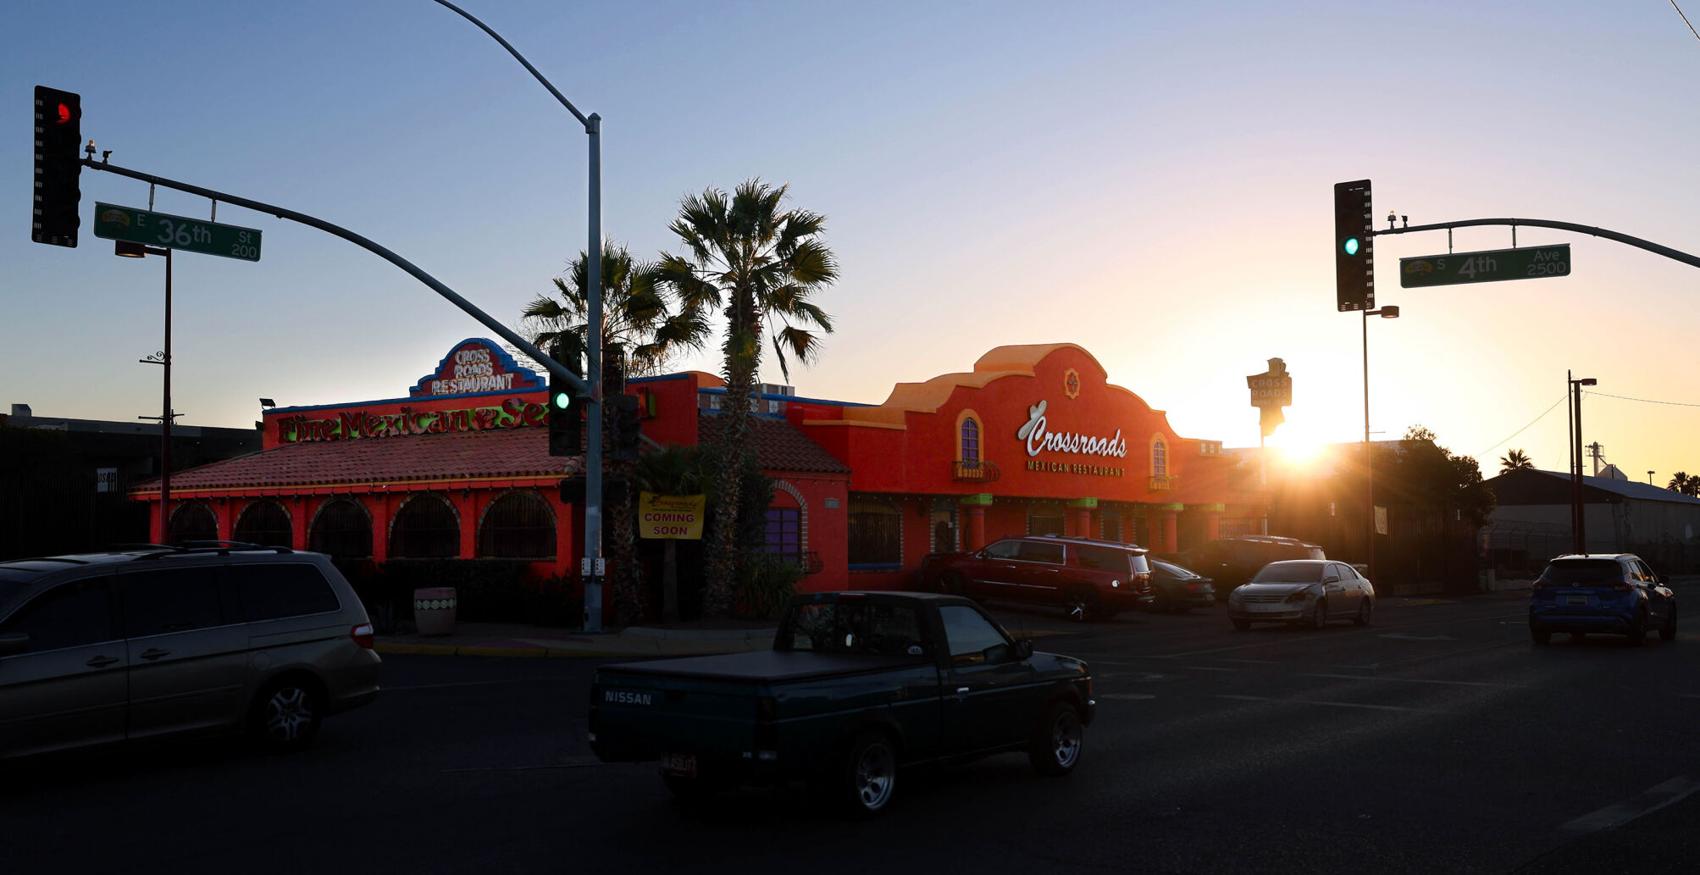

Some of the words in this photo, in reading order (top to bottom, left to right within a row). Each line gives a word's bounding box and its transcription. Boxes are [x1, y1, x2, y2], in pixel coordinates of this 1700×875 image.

[136, 213, 146, 227] E
[157, 218, 212, 246] 36th
[238, 230, 251, 244] St
[231, 243, 257, 258] 200
[1436, 258, 1446, 271] S
[1458, 256, 1497, 279] 4th
[1533, 249, 1560, 262] Ave
[1527, 261, 1568, 277] 2500
[455, 348, 491, 365] CROSS
[454, 362, 493, 379] ROADS
[431, 372, 514, 395] RESTAURANT
[277, 405, 338, 443] Fine
[1026, 415, 1127, 458] Crossroads
[1027, 460, 1070, 473] MEXICAN
[1073, 463, 1125, 477] RESTAURANT
[644, 512, 695, 523] COMING
[653, 525, 688, 535] SOON
[604, 690, 652, 705] NISSAN
